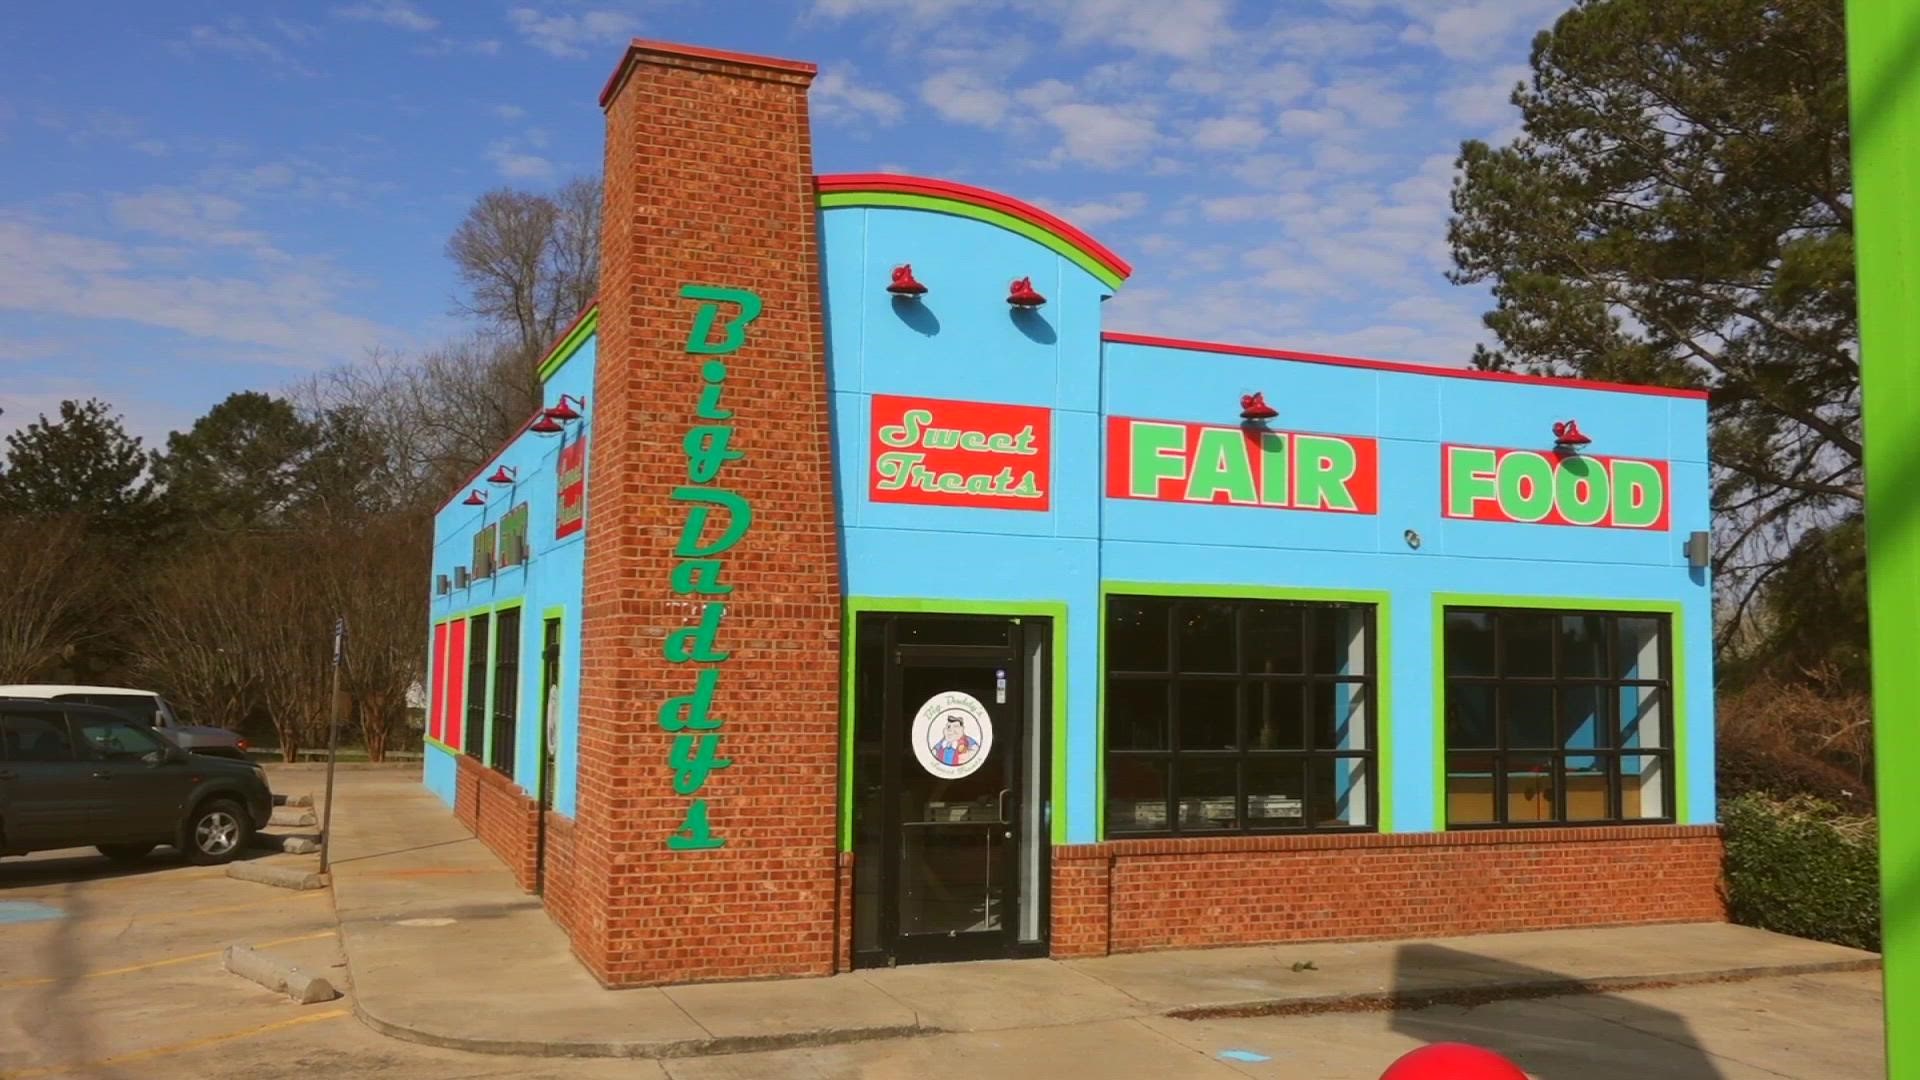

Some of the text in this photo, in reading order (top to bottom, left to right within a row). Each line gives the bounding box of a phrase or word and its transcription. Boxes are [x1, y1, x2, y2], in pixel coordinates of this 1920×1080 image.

[879, 409, 1038, 455] Sweet
[876, 451, 1043, 498] Treats
[1129, 420, 1663, 527] FAIR FOOD
[659, 285, 762, 851] Big Daddys
